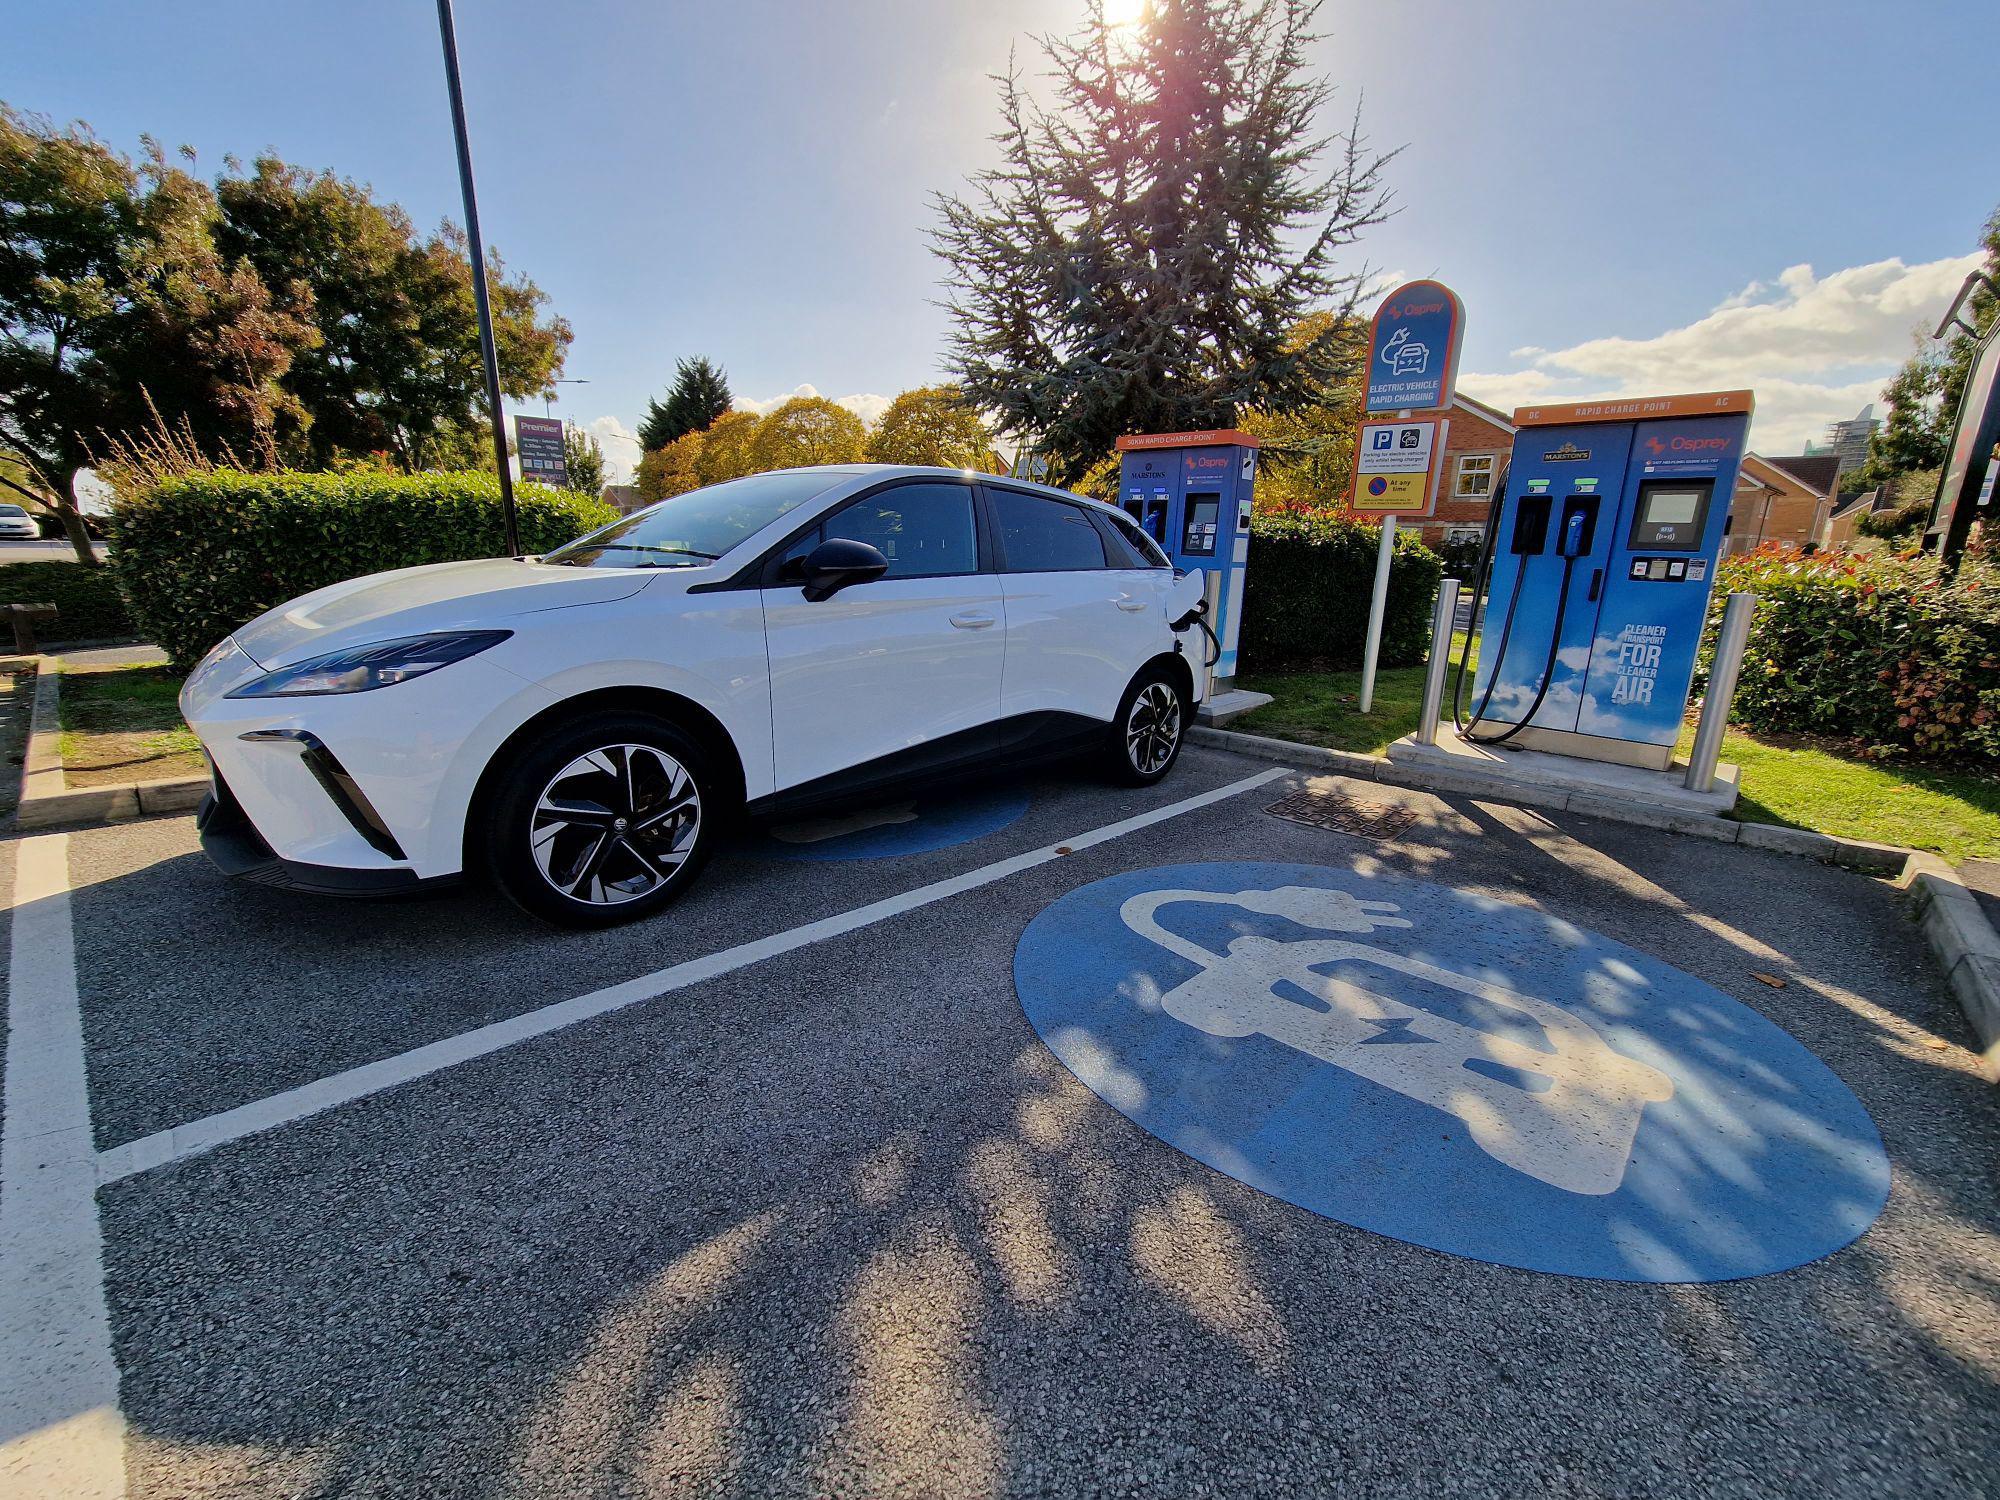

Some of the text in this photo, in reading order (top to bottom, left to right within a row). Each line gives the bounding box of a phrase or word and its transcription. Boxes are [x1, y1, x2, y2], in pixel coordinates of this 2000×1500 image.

[1404, 303, 1443, 316] Osprey
[1370, 380, 1439, 393] ELECTRIC VEHICLE
[1370, 392, 1434, 404] RAPID CHARGING
[1715, 398, 1728, 406] AC
[1529, 411, 1540, 419] DC
[1576, 402, 1672, 416] RAPID CHARGE POINT
[521, 422, 559, 433] Premier
[1671, 437, 1731, 452] Osprey
[1199, 457, 1228, 469] Osprey
[1625, 624, 1667, 637] CLEANER
[1624, 635, 1664, 645] TRANSPORT
[1618, 643, 1662, 668] FOR
[1617, 665, 1658, 679] CLEANER
[1611, 676, 1655, 703] AIR
